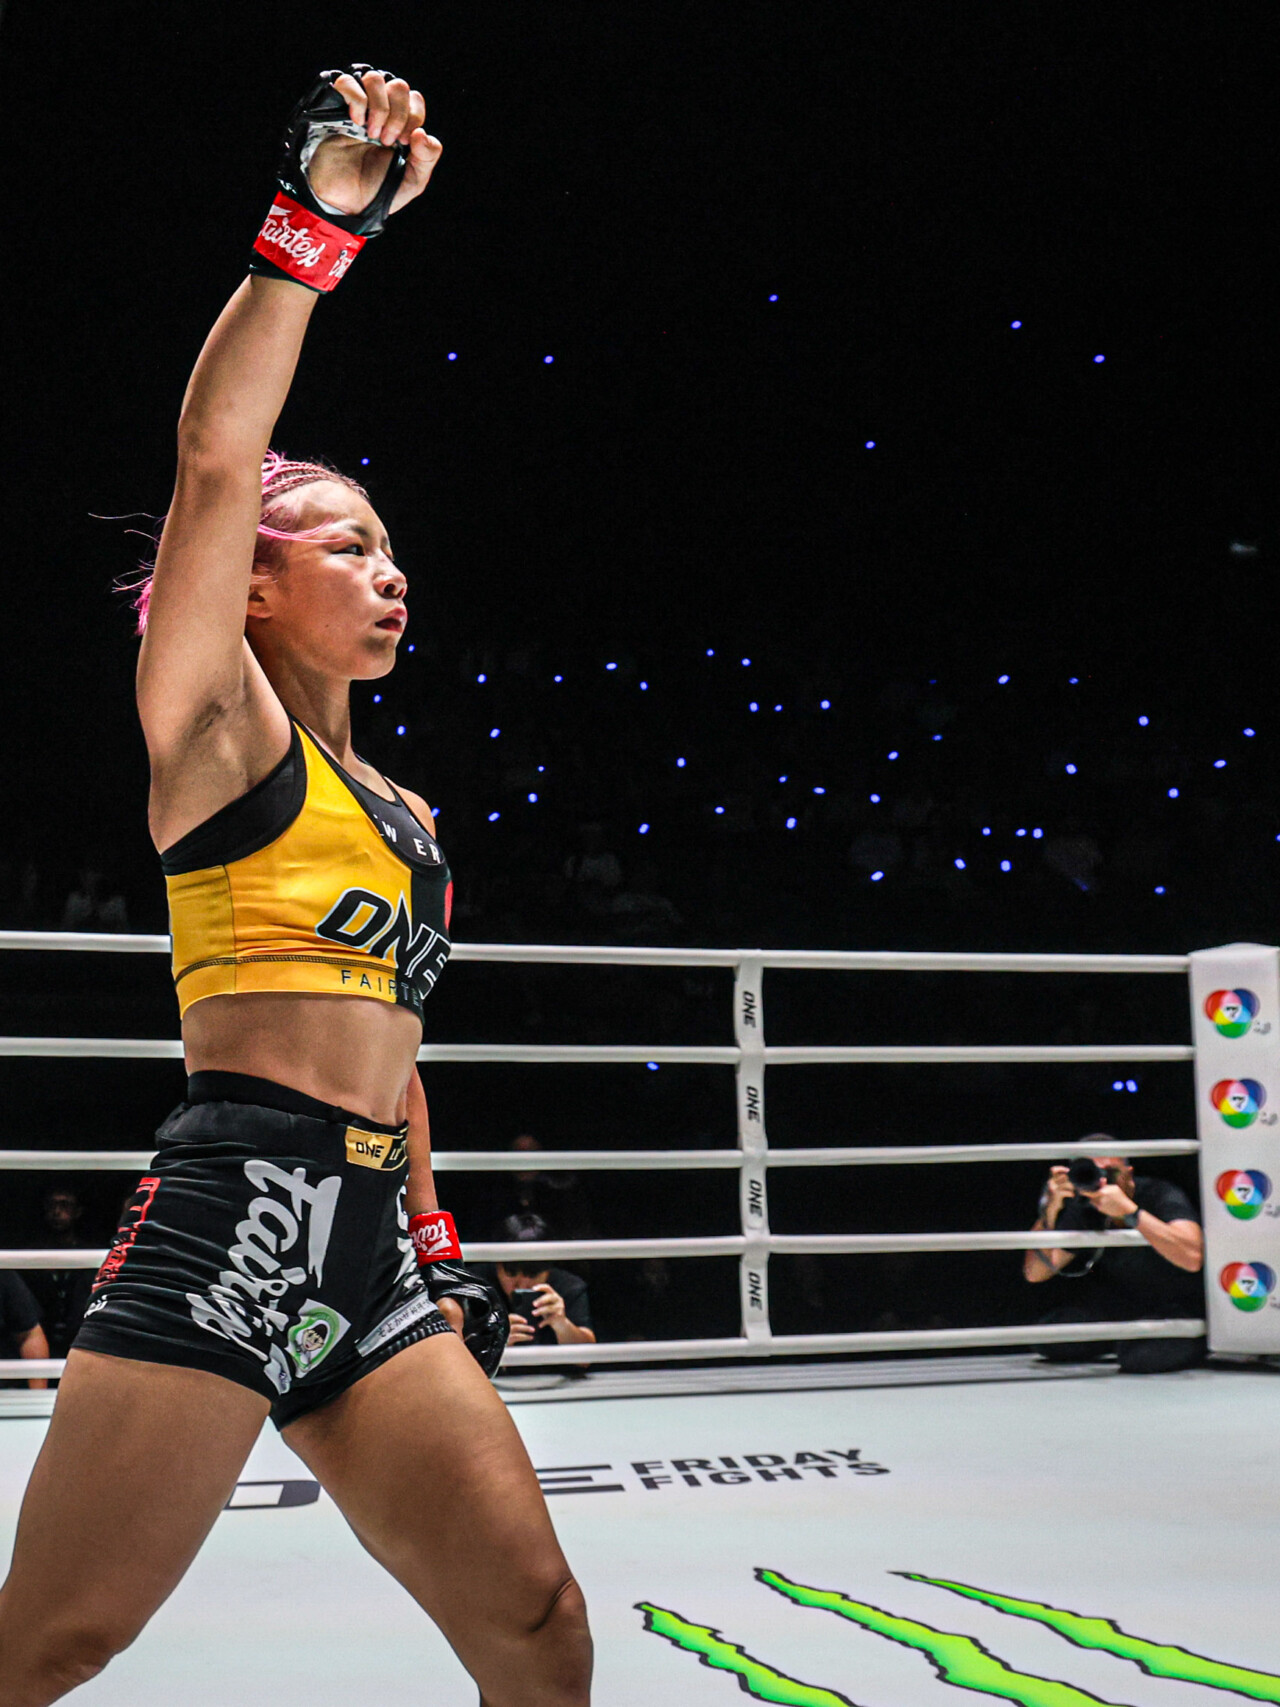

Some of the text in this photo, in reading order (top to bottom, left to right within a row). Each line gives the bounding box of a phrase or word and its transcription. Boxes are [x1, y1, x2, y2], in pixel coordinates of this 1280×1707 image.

[314, 886, 452, 1001] ONE
[741, 990, 757, 1029] ONE
[745, 1086, 761, 1124] ONE
[355, 1140, 385, 1160] ONE
[748, 1179, 764, 1219] ONE
[748, 1271, 763, 1312] ONE
[630, 1448, 864, 1475] FRIDAY
[640, 1462, 891, 1491] FIGHTS
